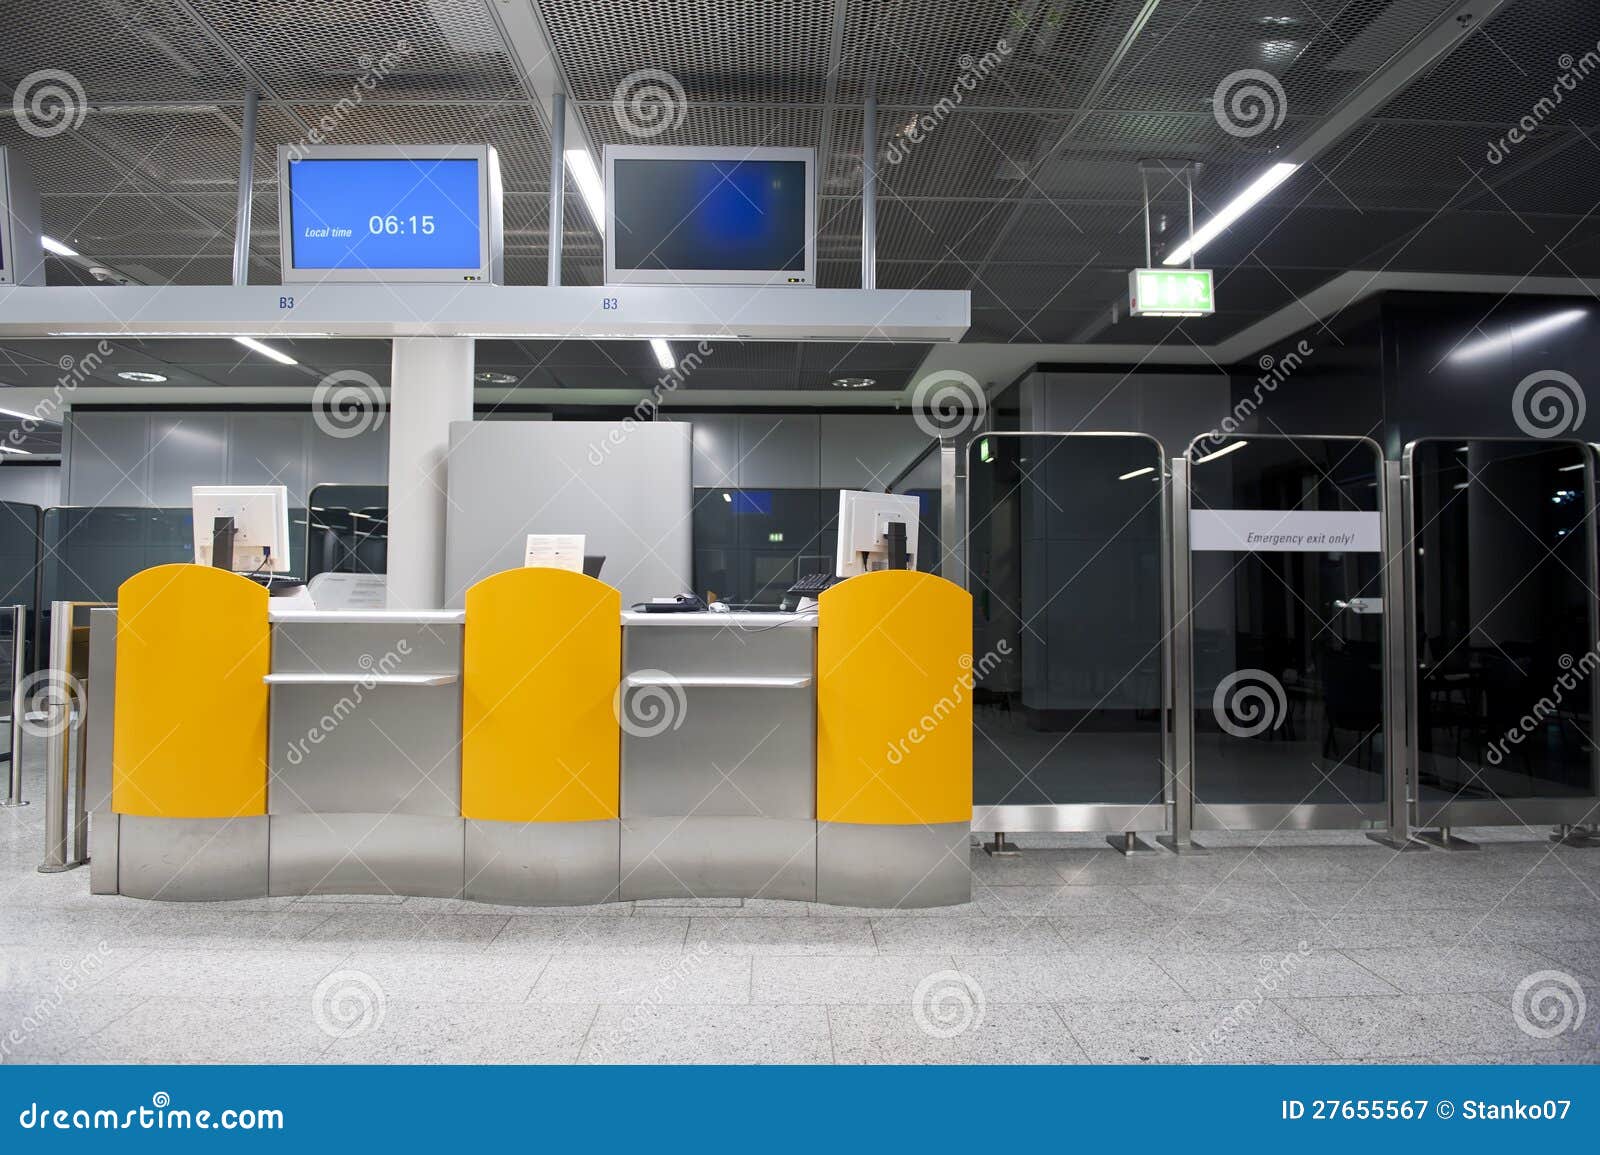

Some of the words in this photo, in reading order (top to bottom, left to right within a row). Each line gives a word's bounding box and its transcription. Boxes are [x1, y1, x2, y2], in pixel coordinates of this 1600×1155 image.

[304, 227, 329, 238] Local
[331, 227, 352, 238] time
[368, 215, 435, 235] 06:15
[279, 297, 295, 309] B3
[603, 297, 618, 310] B3
[1247, 532, 1303, 546] Emergency
[1306, 532, 1326, 544] exit
[1328, 532, 1355, 546] only!
